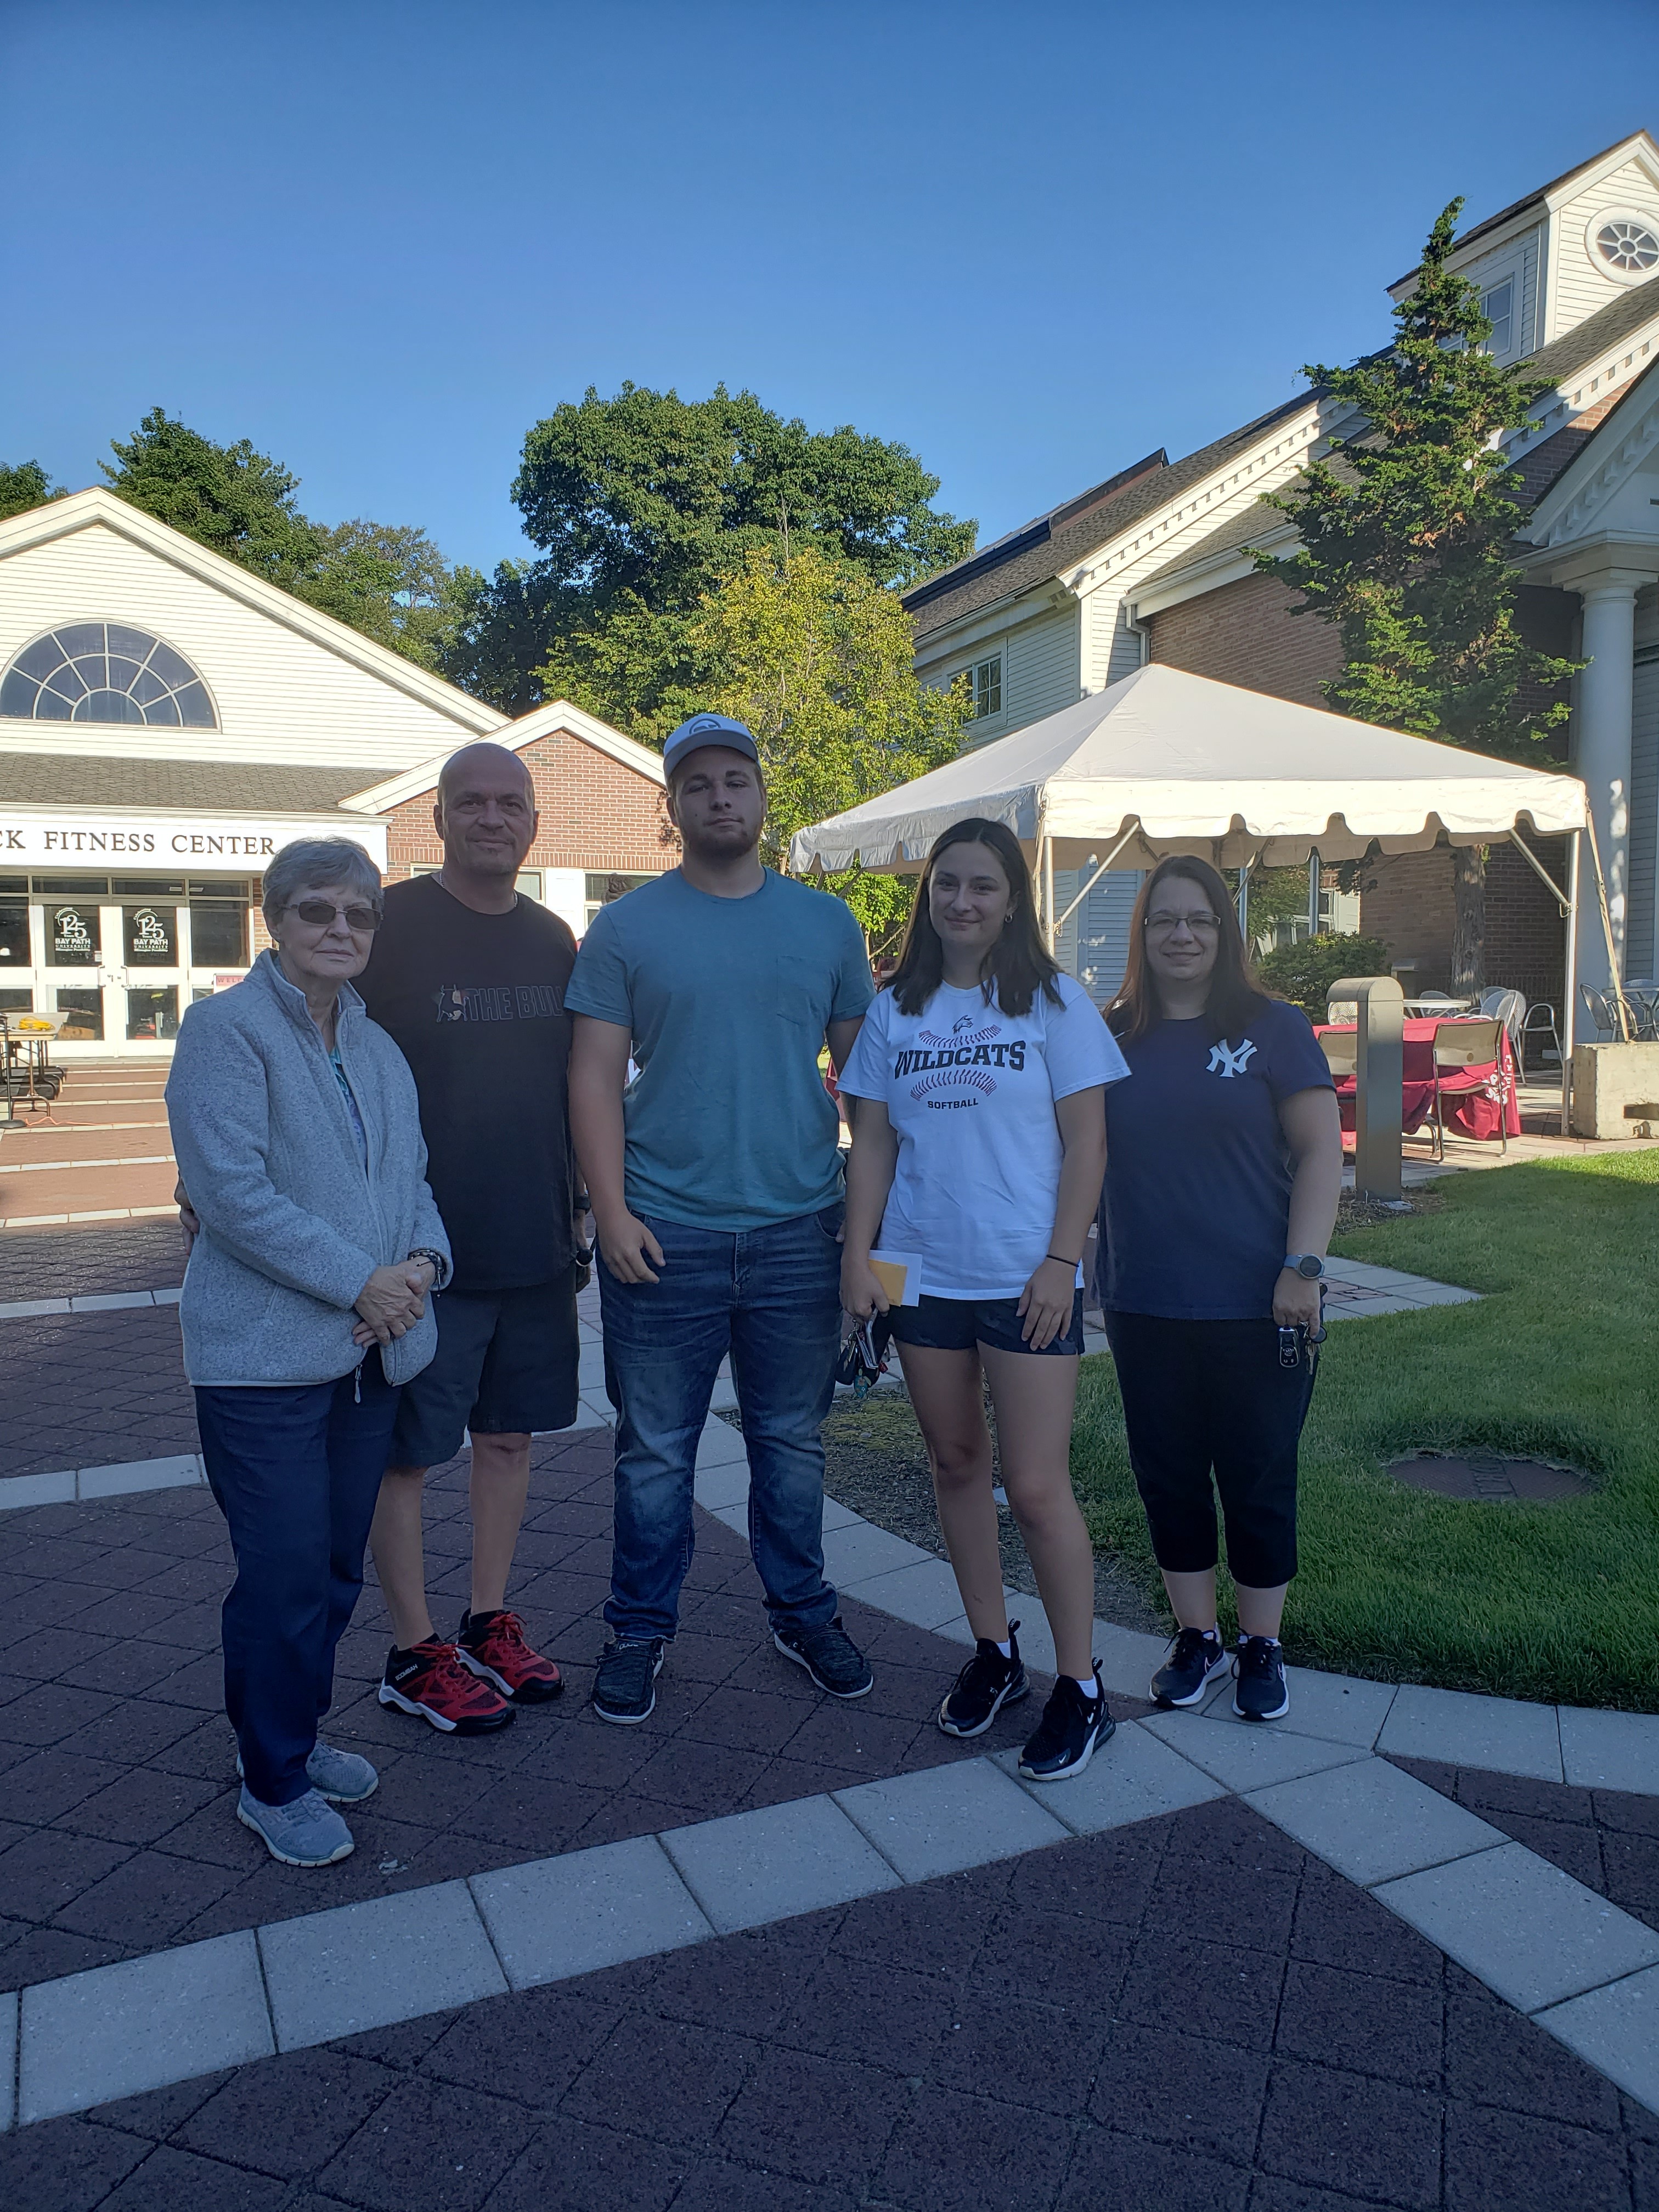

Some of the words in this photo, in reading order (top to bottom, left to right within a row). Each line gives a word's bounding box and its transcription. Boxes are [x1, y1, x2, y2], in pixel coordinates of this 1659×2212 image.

[0, 830, 26, 849] K
[43, 831, 155, 852] FITNESS
[171, 834, 275, 855] CENTER
[60, 915, 87, 939] 125
[138, 915, 165, 940] 125
[465, 988, 514, 1021] THE
[894, 1040, 1026, 1079] WILDCATS
[927, 1098, 979, 1109] SOFTBALL
